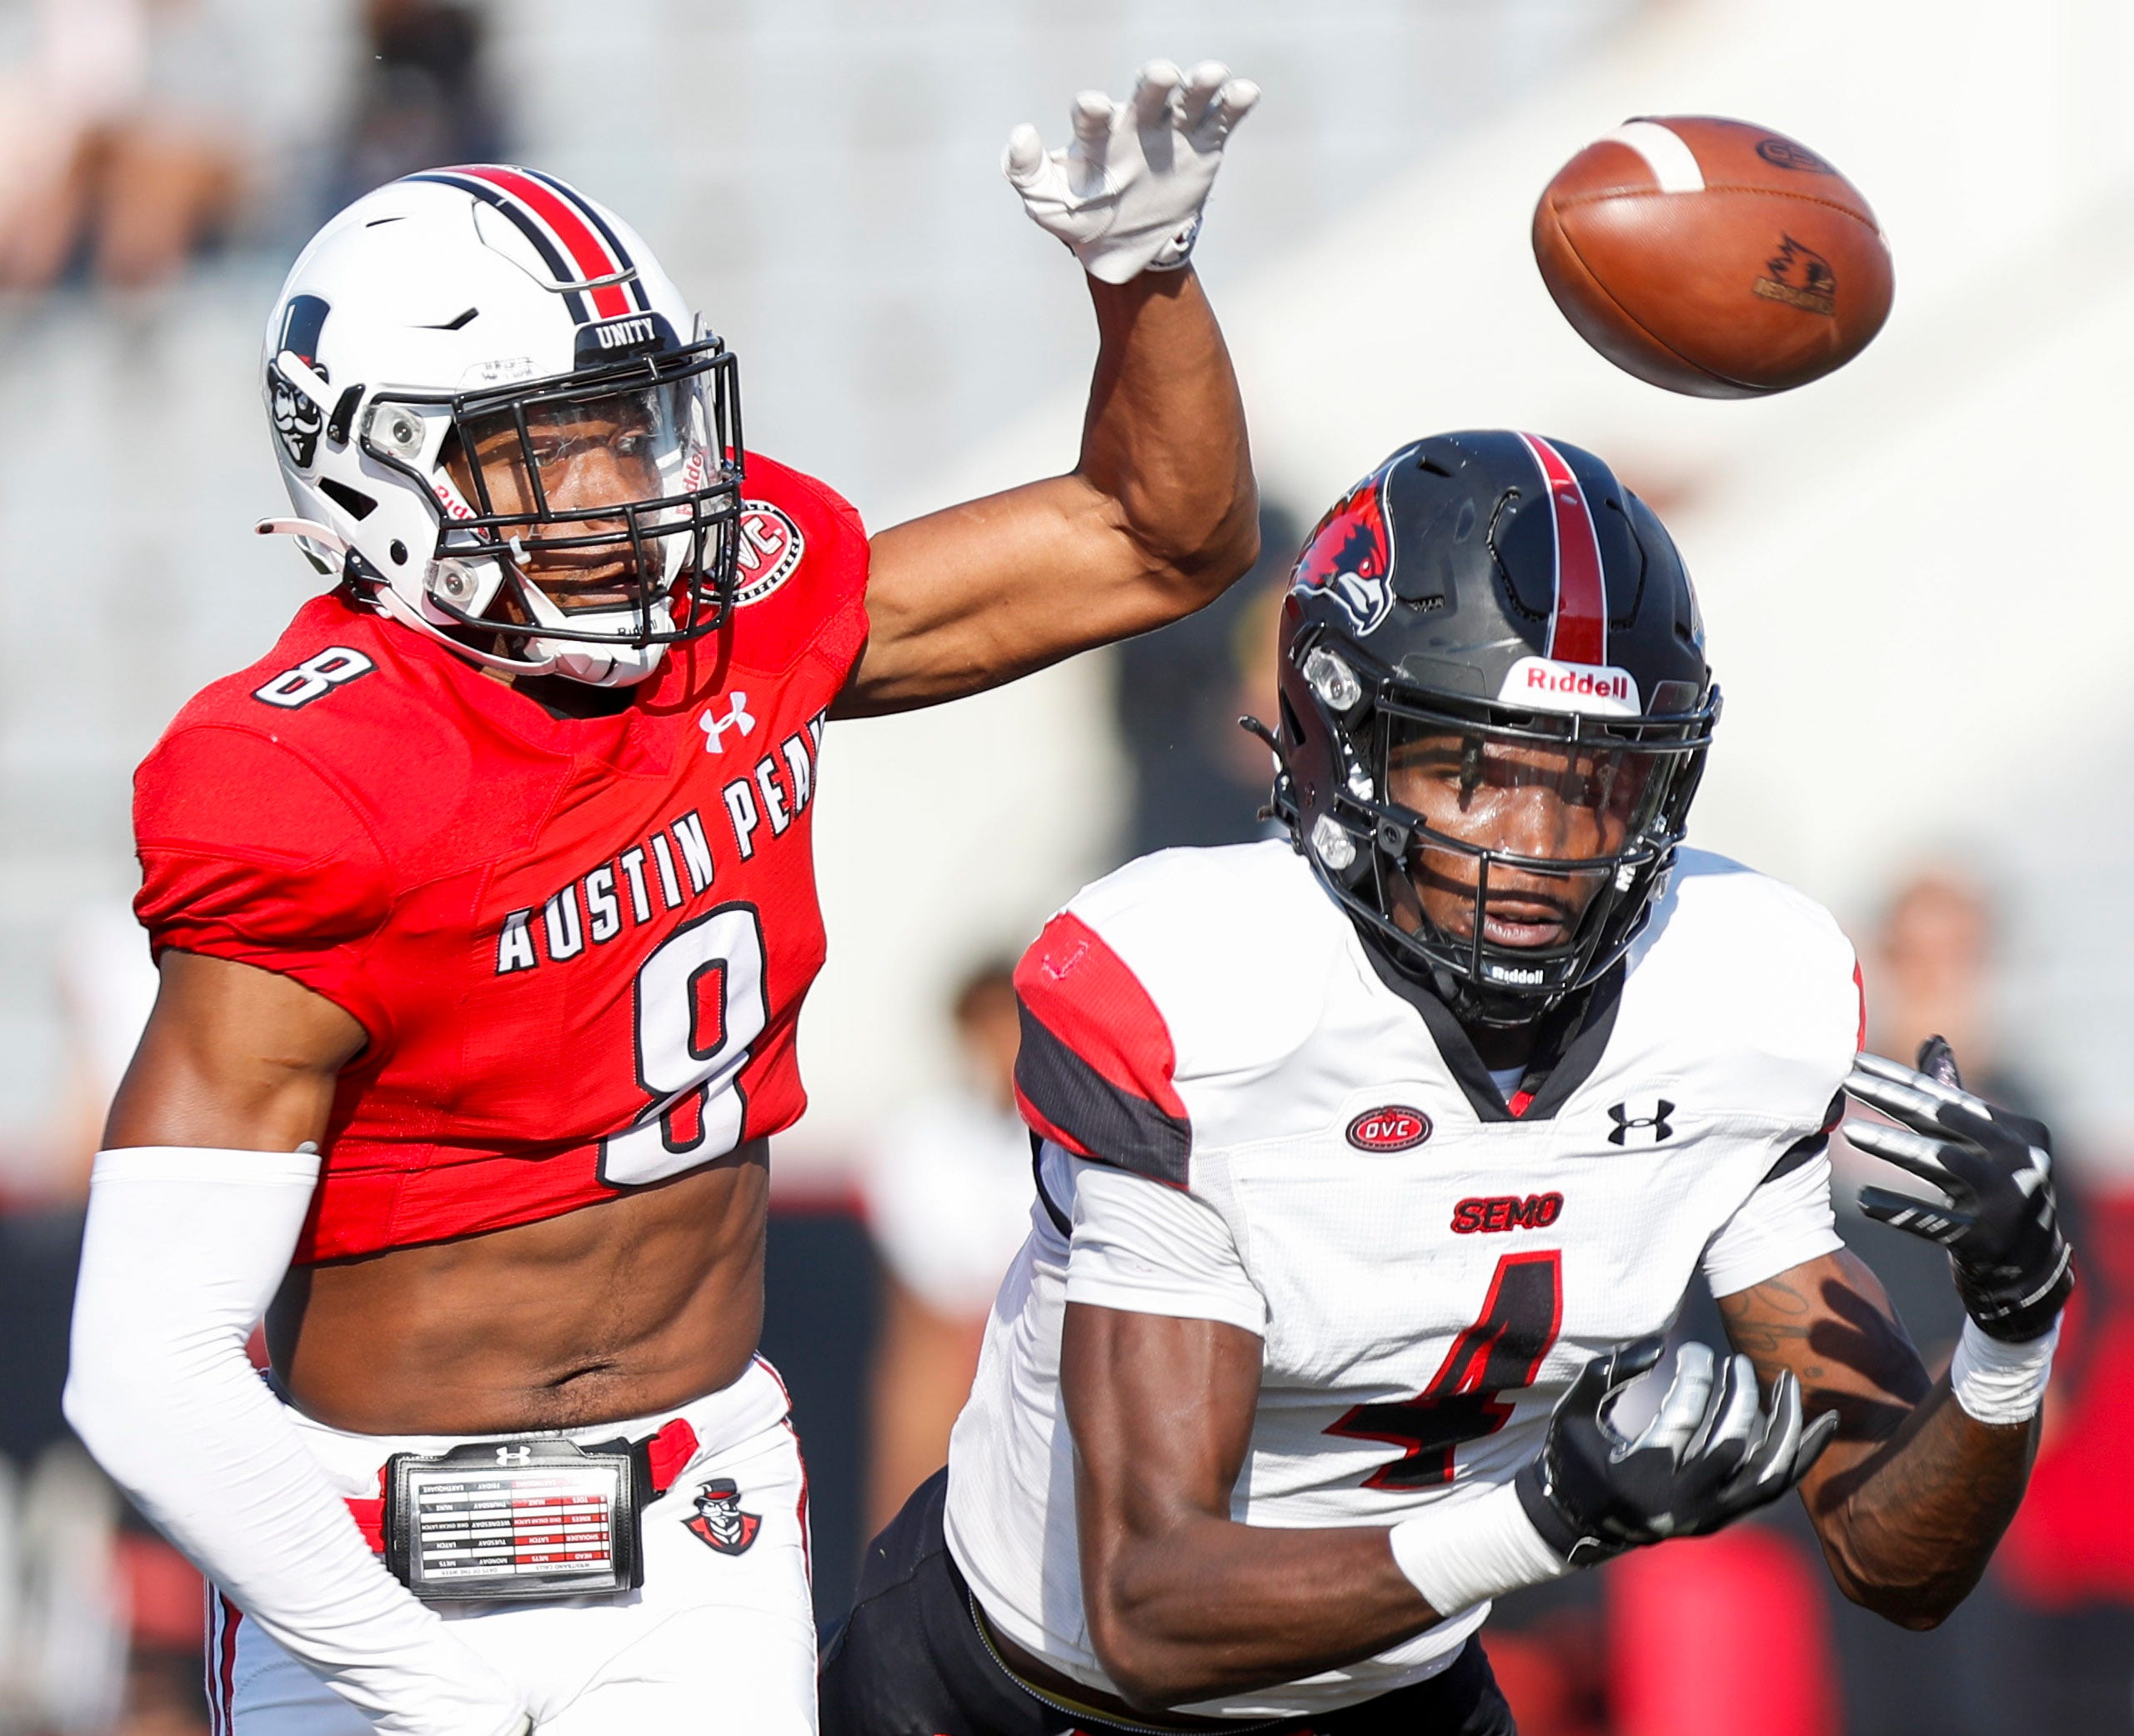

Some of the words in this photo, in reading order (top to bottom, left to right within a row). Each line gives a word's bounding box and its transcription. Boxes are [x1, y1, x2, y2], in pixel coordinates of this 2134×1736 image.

[595, 318, 655, 349] UNITY
[250, 645, 378, 710] 8
[1527, 668, 1628, 699] Riddell
[495, 808, 714, 976] AUSTIN
[1492, 966, 1544, 984] Riddell
[594, 900, 769, 1190] 8
[1365, 1120, 1410, 1138] OVC
[1450, 1191, 1564, 1234] SEMO
[1321, 1248, 1563, 1490] 4
[473, 1501, 507, 1509] THURSDAY
[471, 1520, 511, 1528] WEDNESDAY
[566, 1533, 600, 1542] SHOULDER
